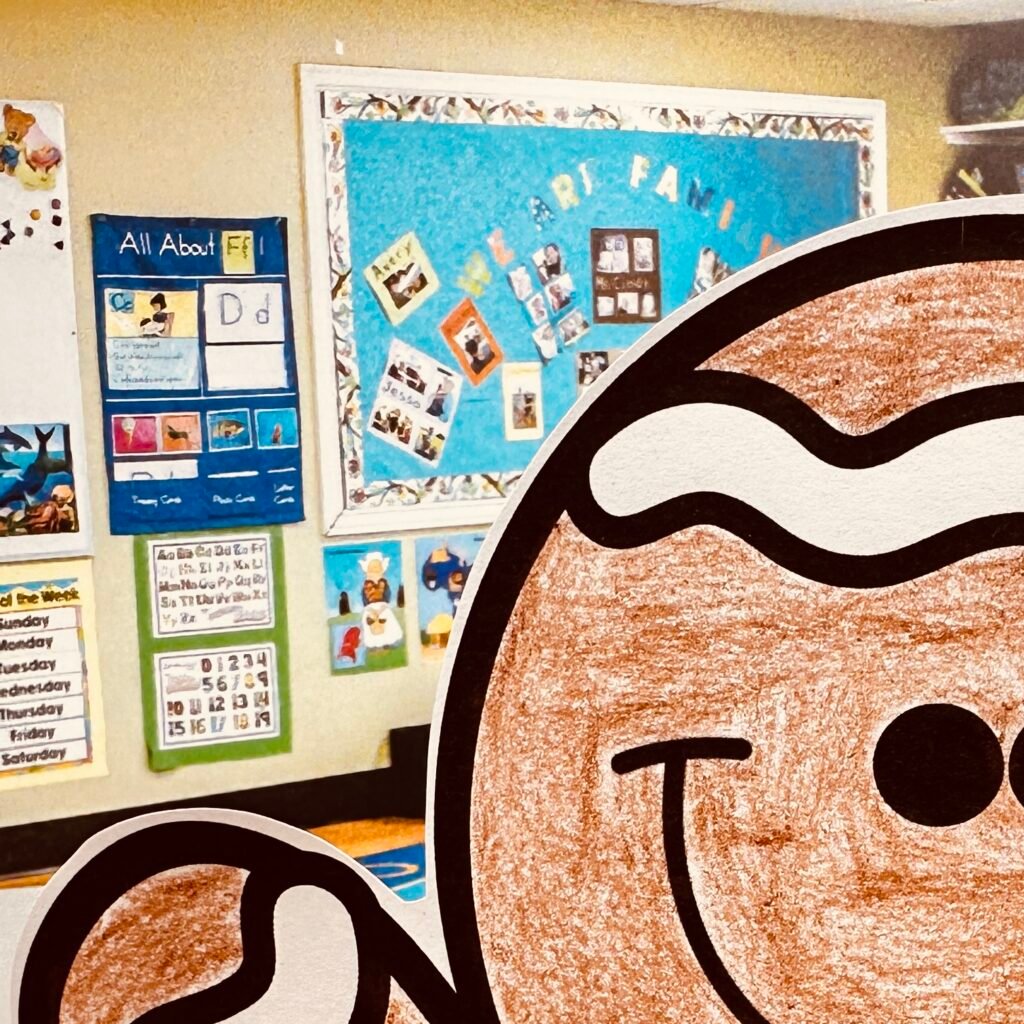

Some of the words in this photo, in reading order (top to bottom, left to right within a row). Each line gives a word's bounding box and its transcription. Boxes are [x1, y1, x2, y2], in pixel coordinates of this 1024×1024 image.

[119, 232, 151, 255] All
[159, 231, 216, 256] About
[0, 680, 71, 697] ednesday
[0, 703, 63, 720] Thursday
[10, 727, 56, 742] Friday
[2, 748, 66, 766] Saturday
